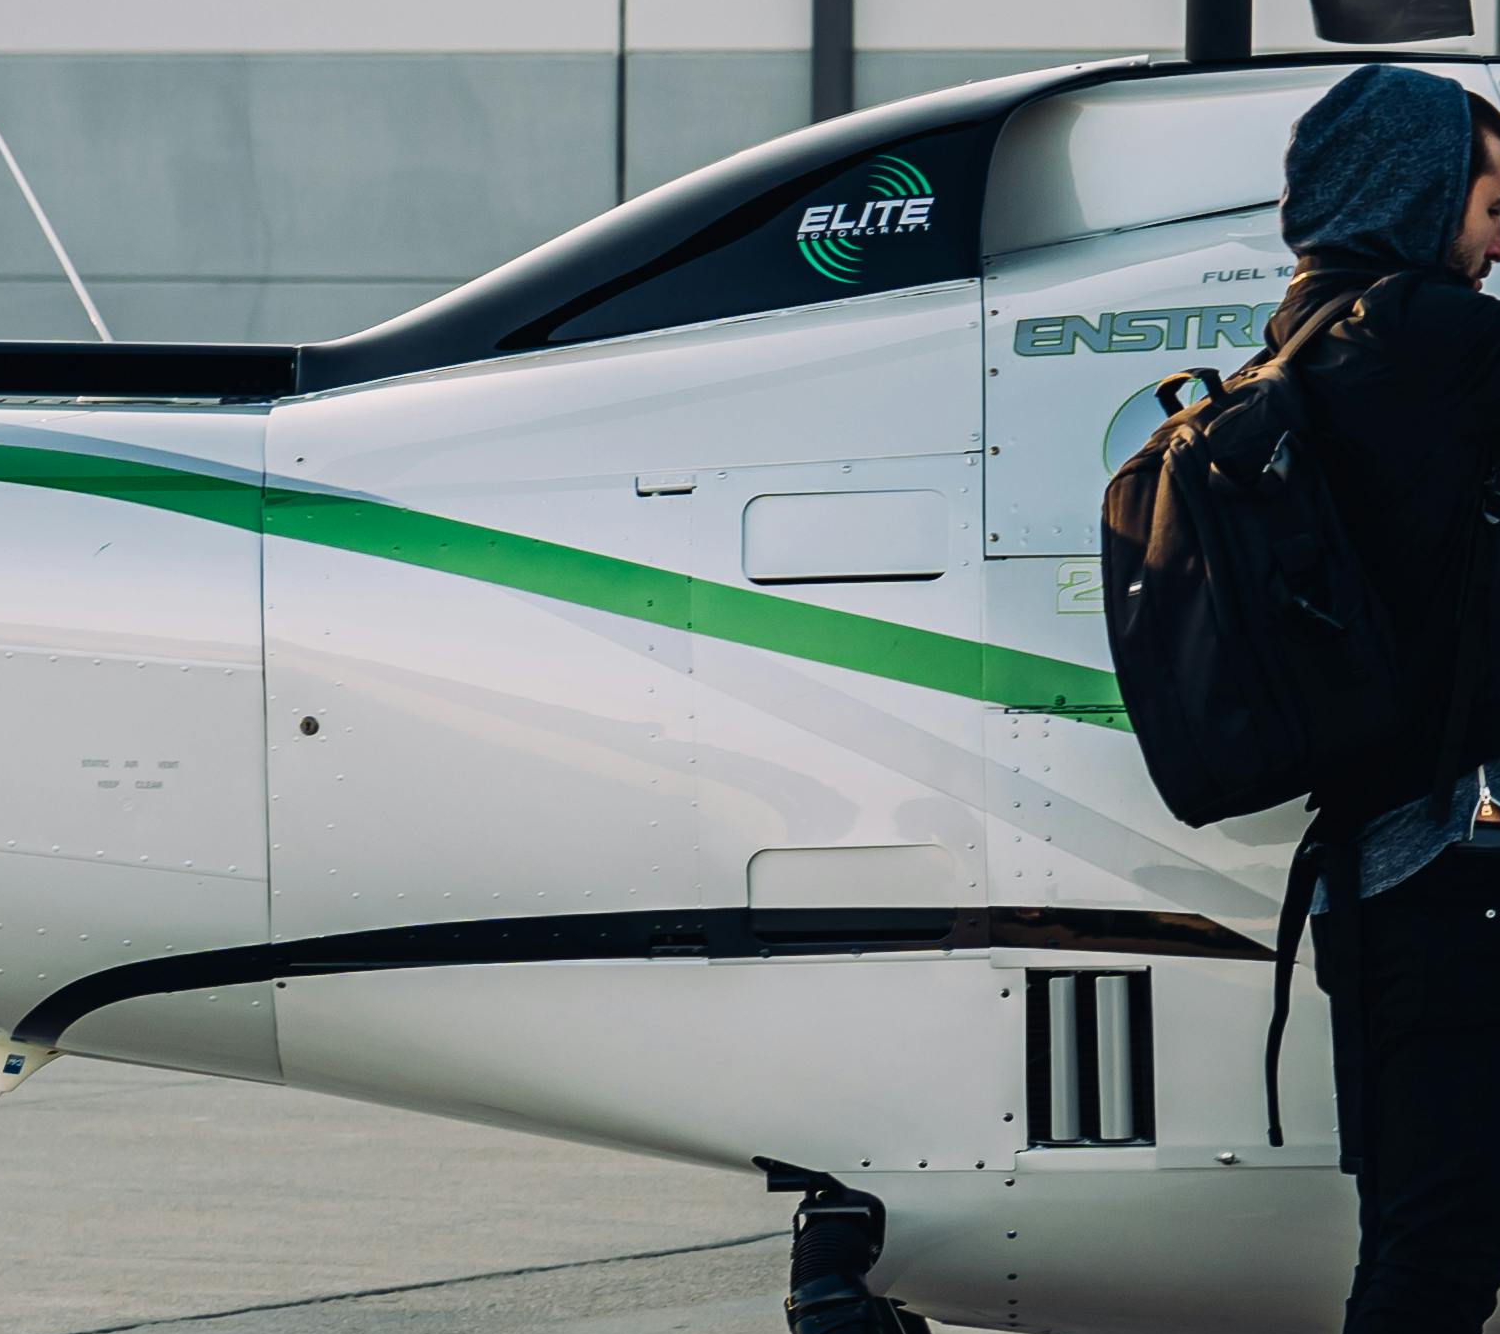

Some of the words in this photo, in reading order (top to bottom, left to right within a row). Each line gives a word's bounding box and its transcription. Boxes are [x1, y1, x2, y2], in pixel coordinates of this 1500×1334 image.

[798, 197, 935, 233] ELITE
[796, 223, 931, 241] ROTORCRAFT
[1202, 268, 1266, 283] FUEL
